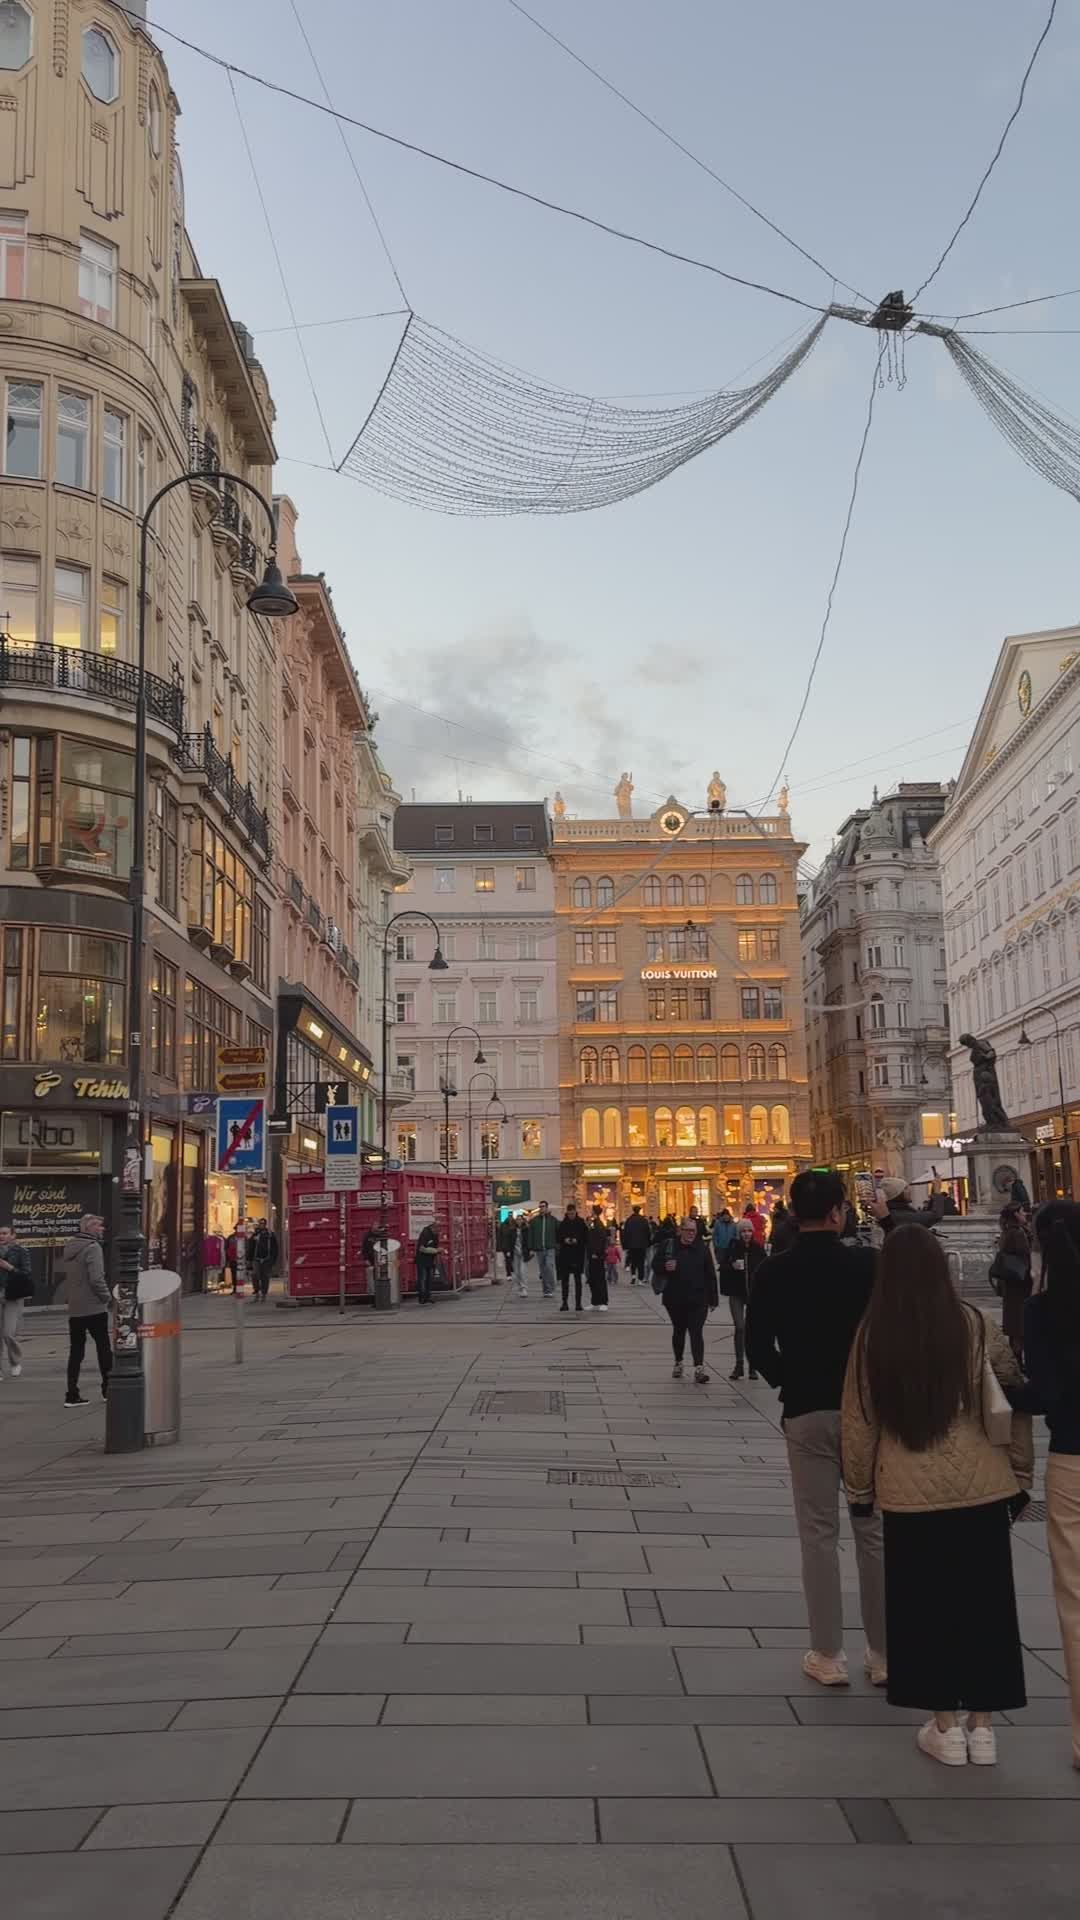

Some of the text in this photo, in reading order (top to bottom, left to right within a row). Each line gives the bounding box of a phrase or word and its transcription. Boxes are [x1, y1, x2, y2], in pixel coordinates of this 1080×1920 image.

[641, 969, 717, 979] LOUIS VUITTON
[73, 1078, 129, 1099] Tchib
[18, 1118, 74, 1148] Qbo
[14, 1185, 66, 1201] Wir sind
[12, 1203, 82, 1218] umgezogen
